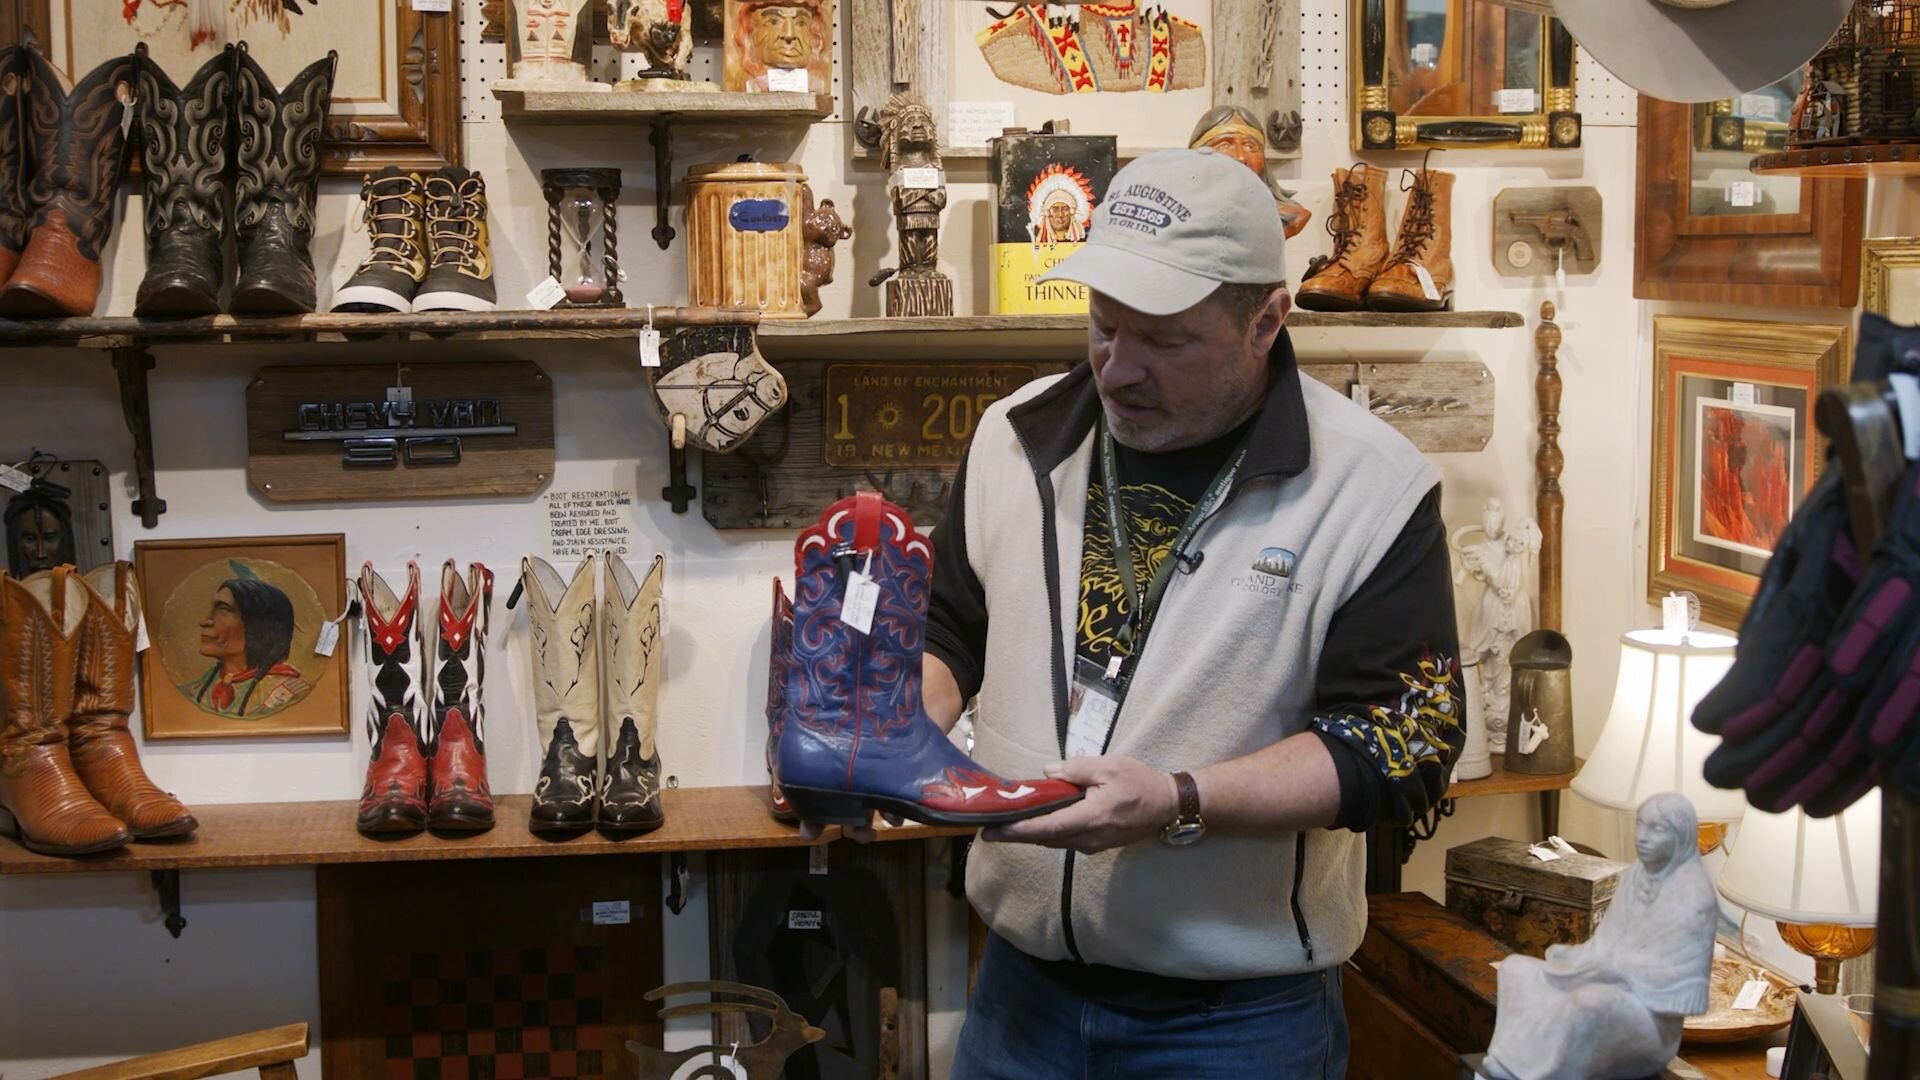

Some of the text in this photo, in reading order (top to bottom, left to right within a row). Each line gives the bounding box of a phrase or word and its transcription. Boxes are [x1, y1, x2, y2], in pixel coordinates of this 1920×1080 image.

[1123, 183, 1192, 223] AUGUSTINE
[1109, 217, 1157, 236] FLORIDA
[1025, 285, 1087, 301] THINNE
[854, 375, 1009, 388] LAND OF ENCHANTMENT
[299, 399, 501, 430] CHEVY VAN
[833, 393, 855, 440] 1
[342, 437, 462, 468] 30
[837, 444, 968, 458] 19 NEW MEXI
[1214, 467, 1237, 497] antique
[550, 490, 621, 501] BOOT RESTORATION
[573, 500, 593, 508] THESE
[595, 498, 615, 507] BOOTS
[549, 508, 617, 518] BEEN RESTORED AND
[550, 519, 577, 527] TREATED
[604, 517, 620, 525] BOOT
[575, 527, 592, 536] EDGE
[552, 539, 566, 547] AND
[566, 538, 586, 546] STAIN
[552, 548, 569, 556] HAVE
[570, 547, 581, 555] ALL
[582, 546, 600, 554] BN
[1231, 573, 1276, 588] GAND
